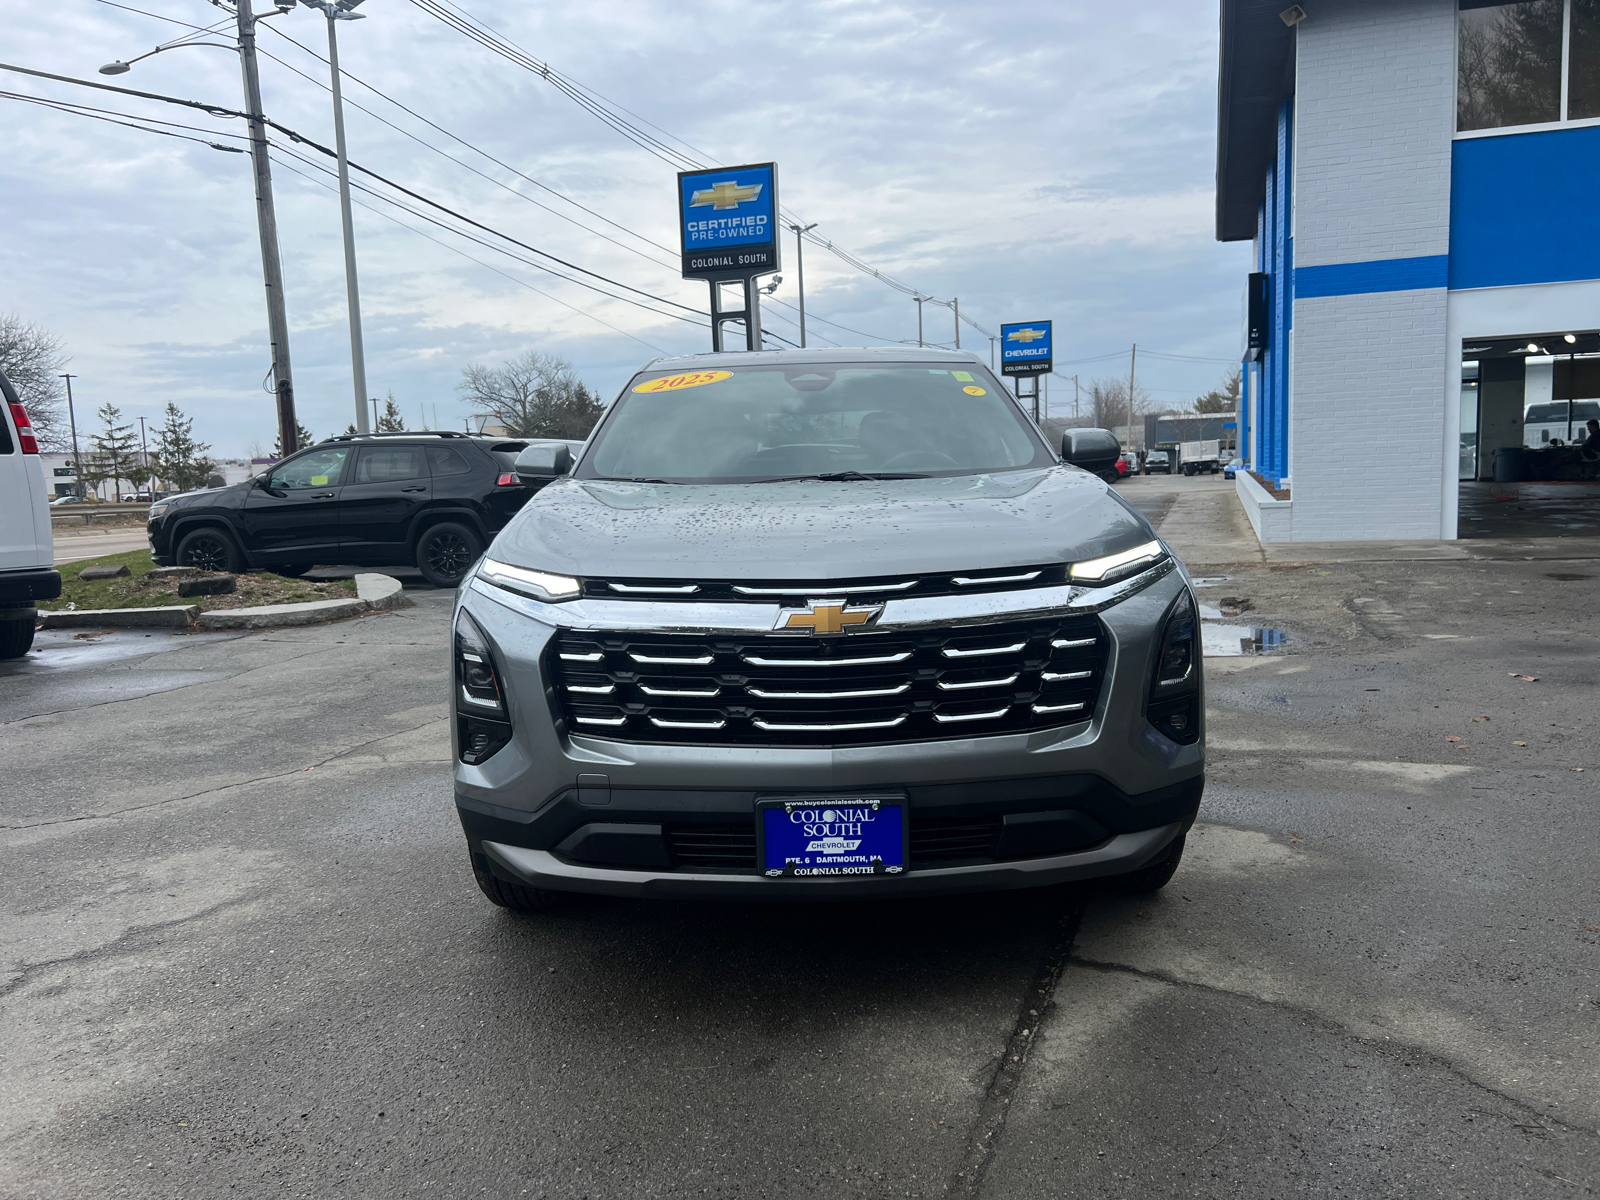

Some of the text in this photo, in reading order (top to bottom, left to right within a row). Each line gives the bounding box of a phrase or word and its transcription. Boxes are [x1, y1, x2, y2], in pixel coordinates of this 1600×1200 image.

[687, 214, 767, 232] CERTIFIED
[691, 226, 764, 241] PRE-OWNED
[691, 253, 767, 268] COLONIAL SOUTH
[1005, 347, 1048, 357] CHEVROLET
[652, 371, 718, 391] 2025
[784, 798, 881, 807] www.buycolonialsouth.com
[789, 809, 876, 823] COLONIAL
[803, 823, 862, 837] SOUTH
[816, 856, 868, 864] DARTMOUTH,
[794, 866, 875, 876] COLONIAL SOUTH
